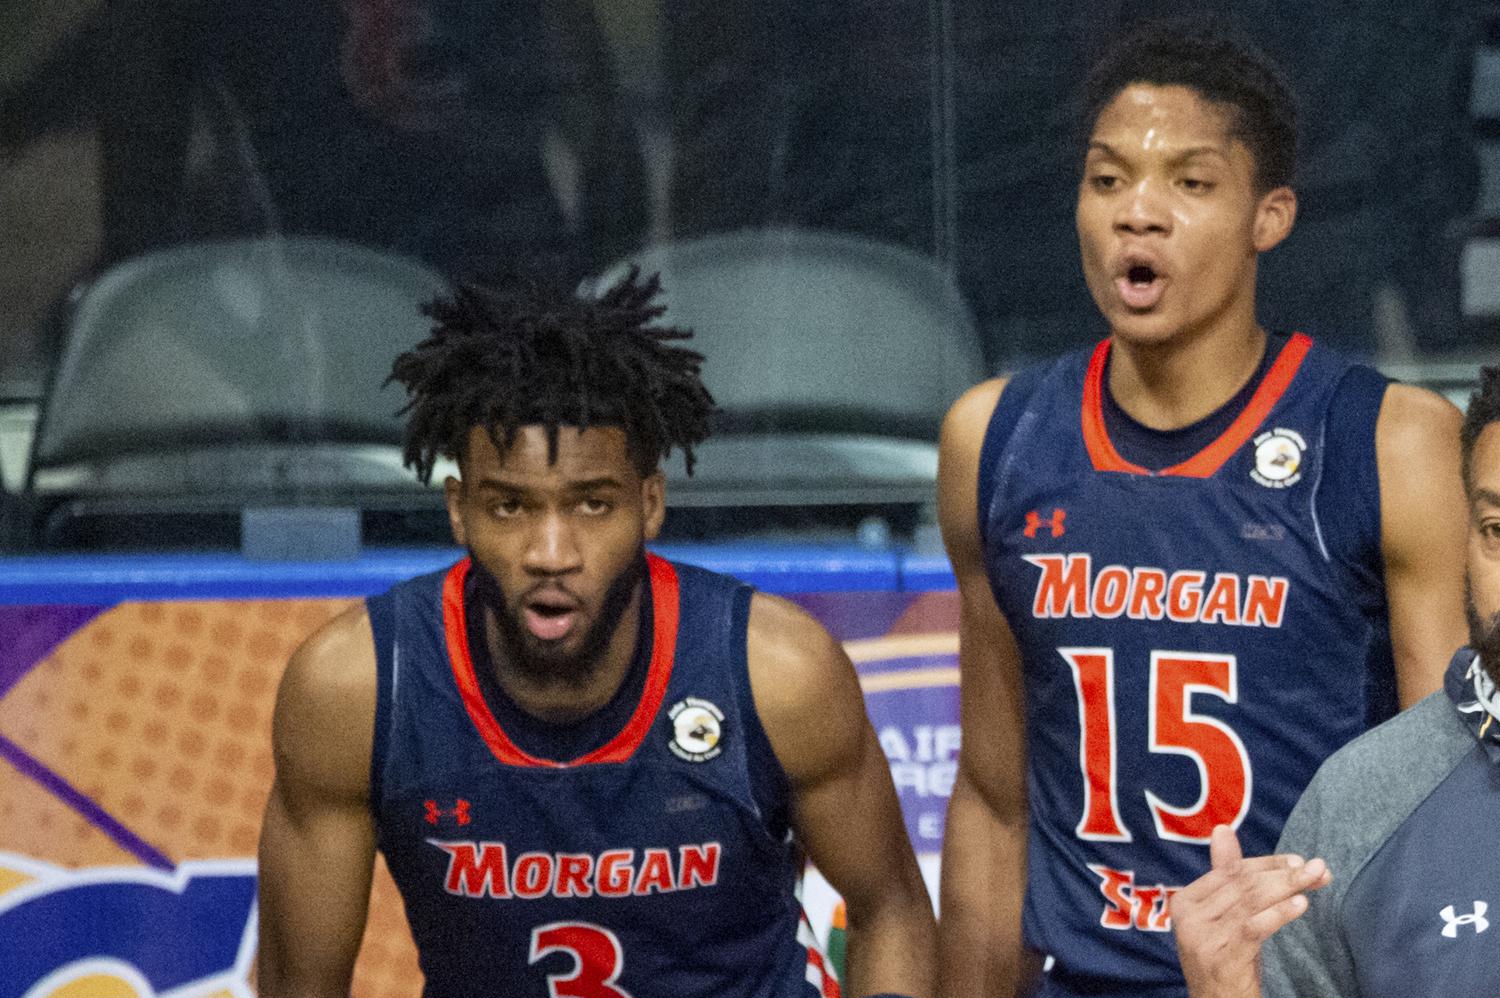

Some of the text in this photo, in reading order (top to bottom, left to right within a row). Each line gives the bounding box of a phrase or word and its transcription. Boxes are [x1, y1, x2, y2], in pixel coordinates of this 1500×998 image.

[1021, 553, 1289, 628] MORGAN
[1056, 646, 1253, 846] 15
[426, 838, 720, 899] MORGAN
